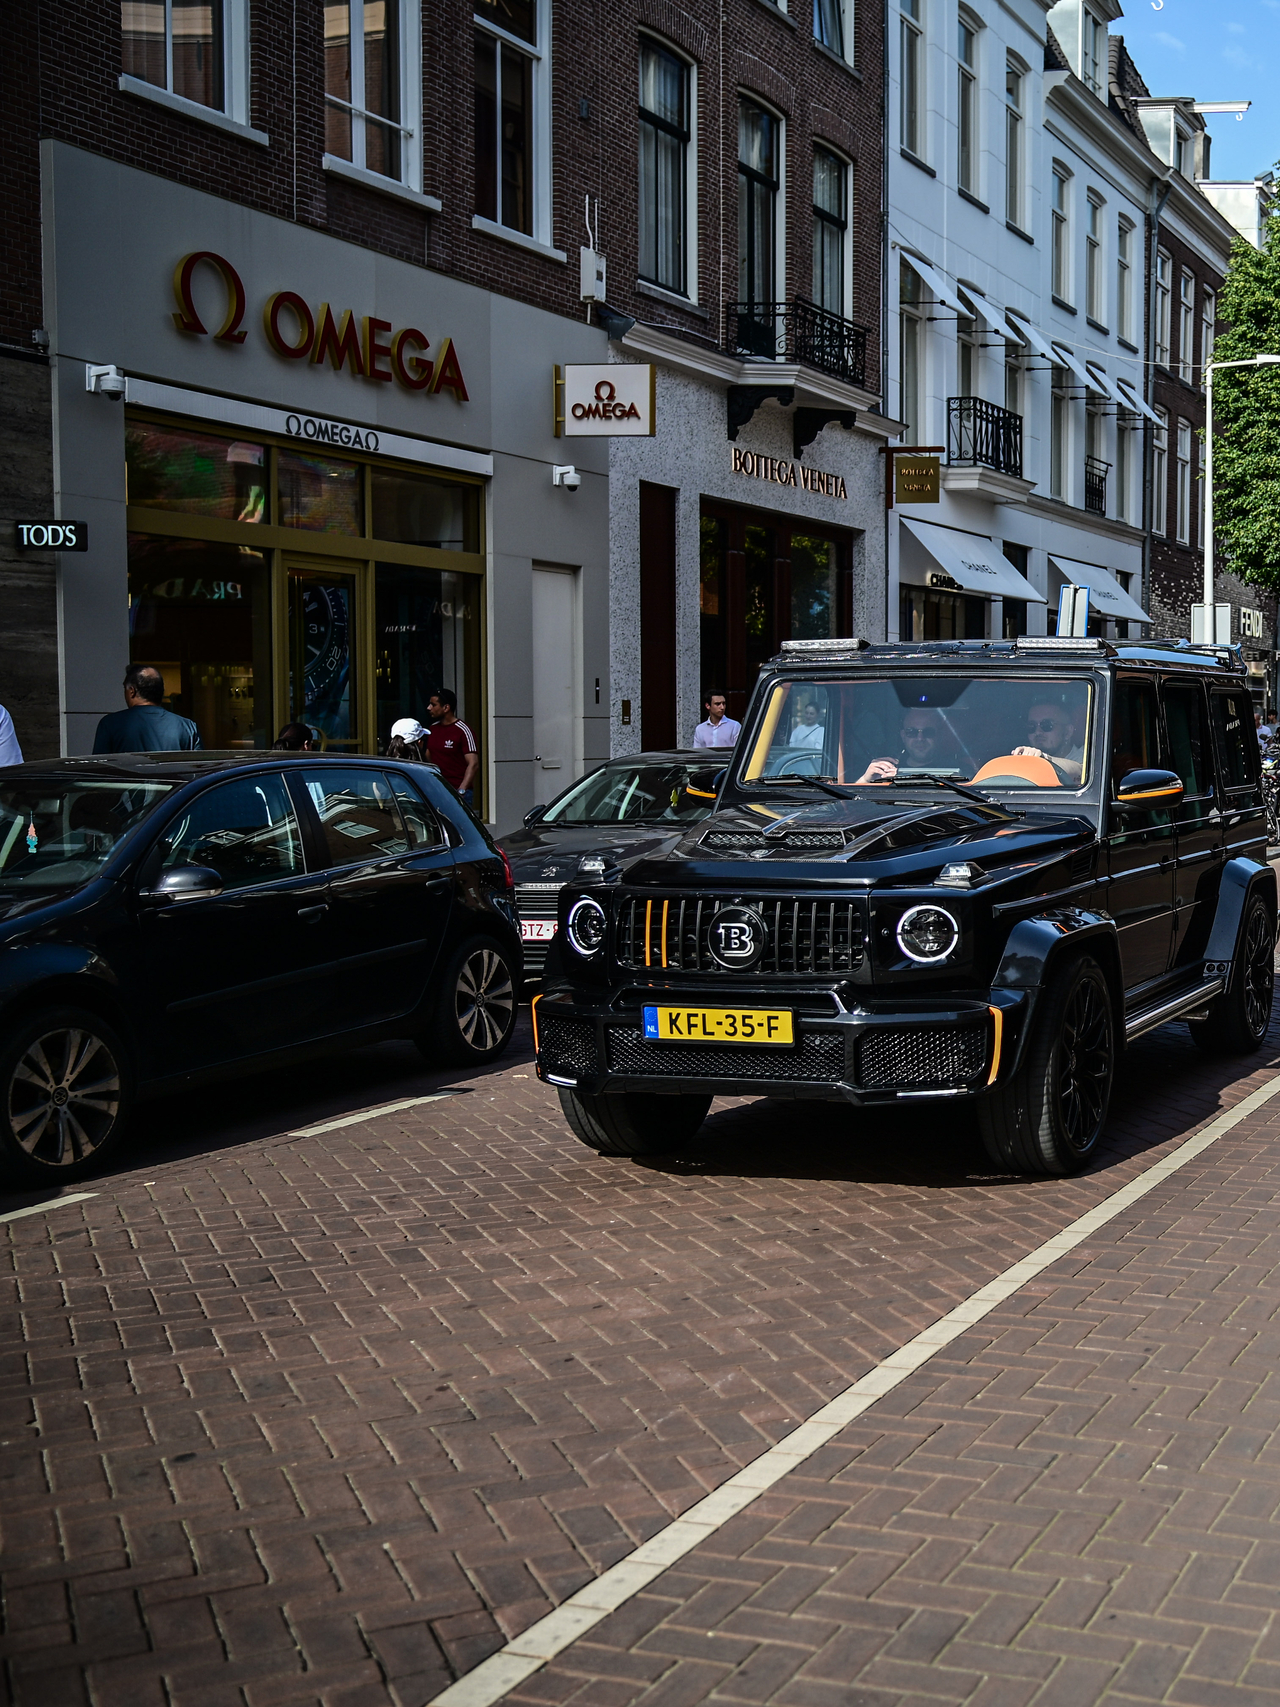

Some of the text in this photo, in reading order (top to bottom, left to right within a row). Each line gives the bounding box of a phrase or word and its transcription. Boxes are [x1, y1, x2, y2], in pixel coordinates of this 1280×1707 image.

[263, 290, 470, 402] OMEGA
[571, 402, 641, 420] OMEGA
[304, 418, 364, 449] OMEGA
[731, 447, 848, 500] BOTTEGA VENETA
[901, 468, 935, 476] BOTTEGA
[18, 524, 77, 547] TOD'S
[961, 561, 997, 574] CHANEL
[1240, 606, 1263, 638] FENDI
[647, 1012, 780, 1038] NL KFL-35-F
